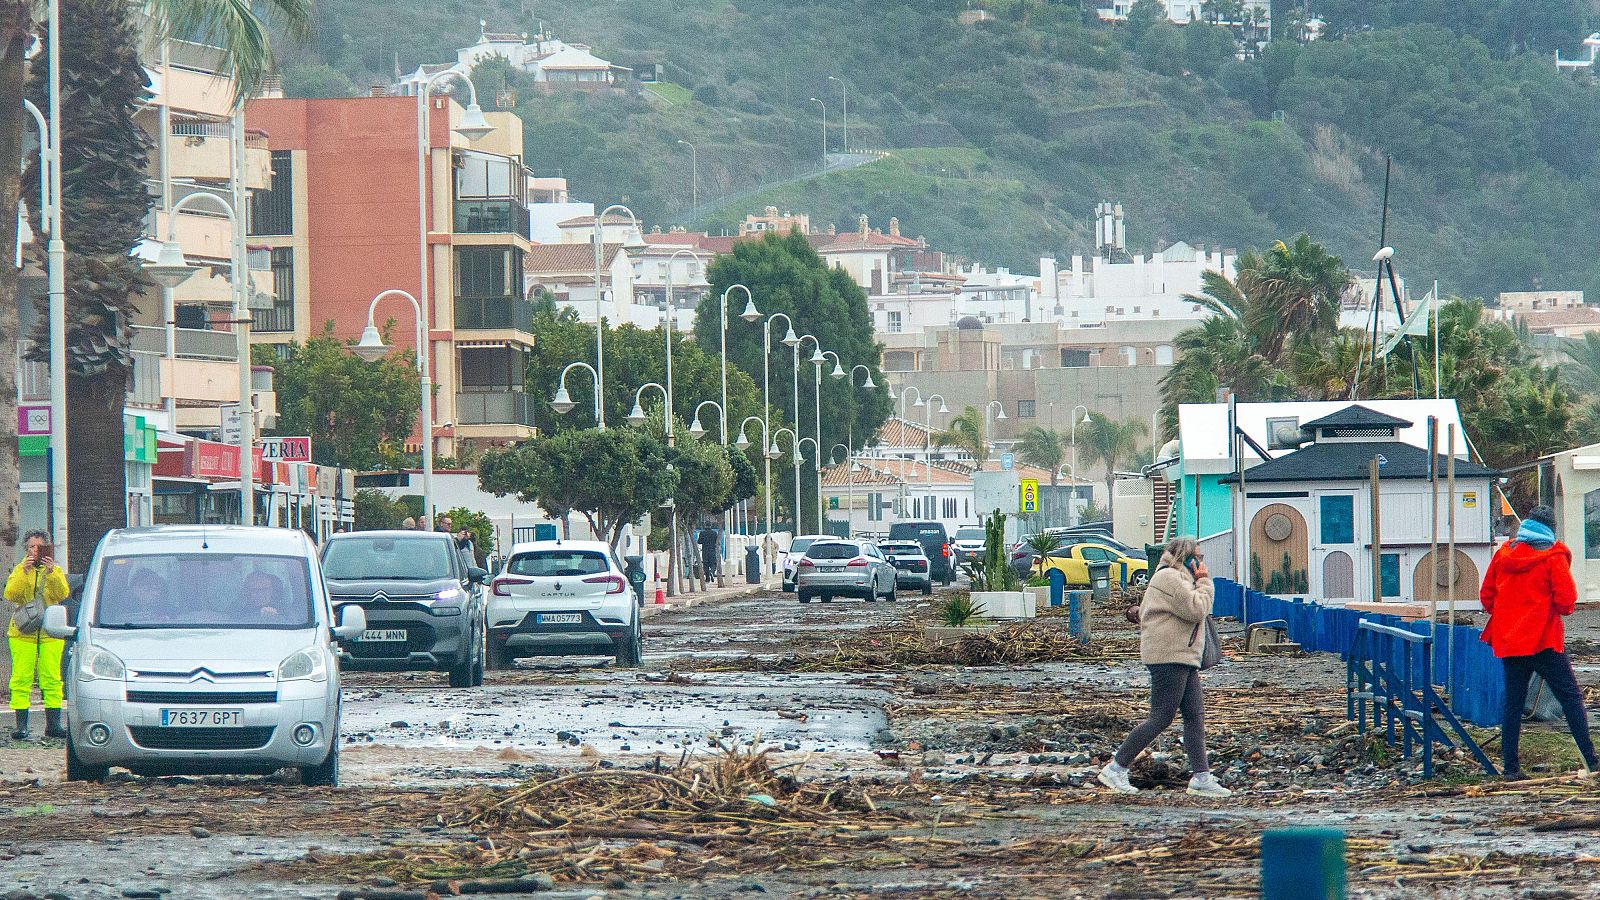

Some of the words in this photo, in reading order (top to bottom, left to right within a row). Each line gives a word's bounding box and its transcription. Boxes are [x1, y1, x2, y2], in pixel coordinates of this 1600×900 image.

[385, 631, 405, 640] MNN
[169, 711, 208, 725] 7637
[212, 711, 240, 725] GPT
